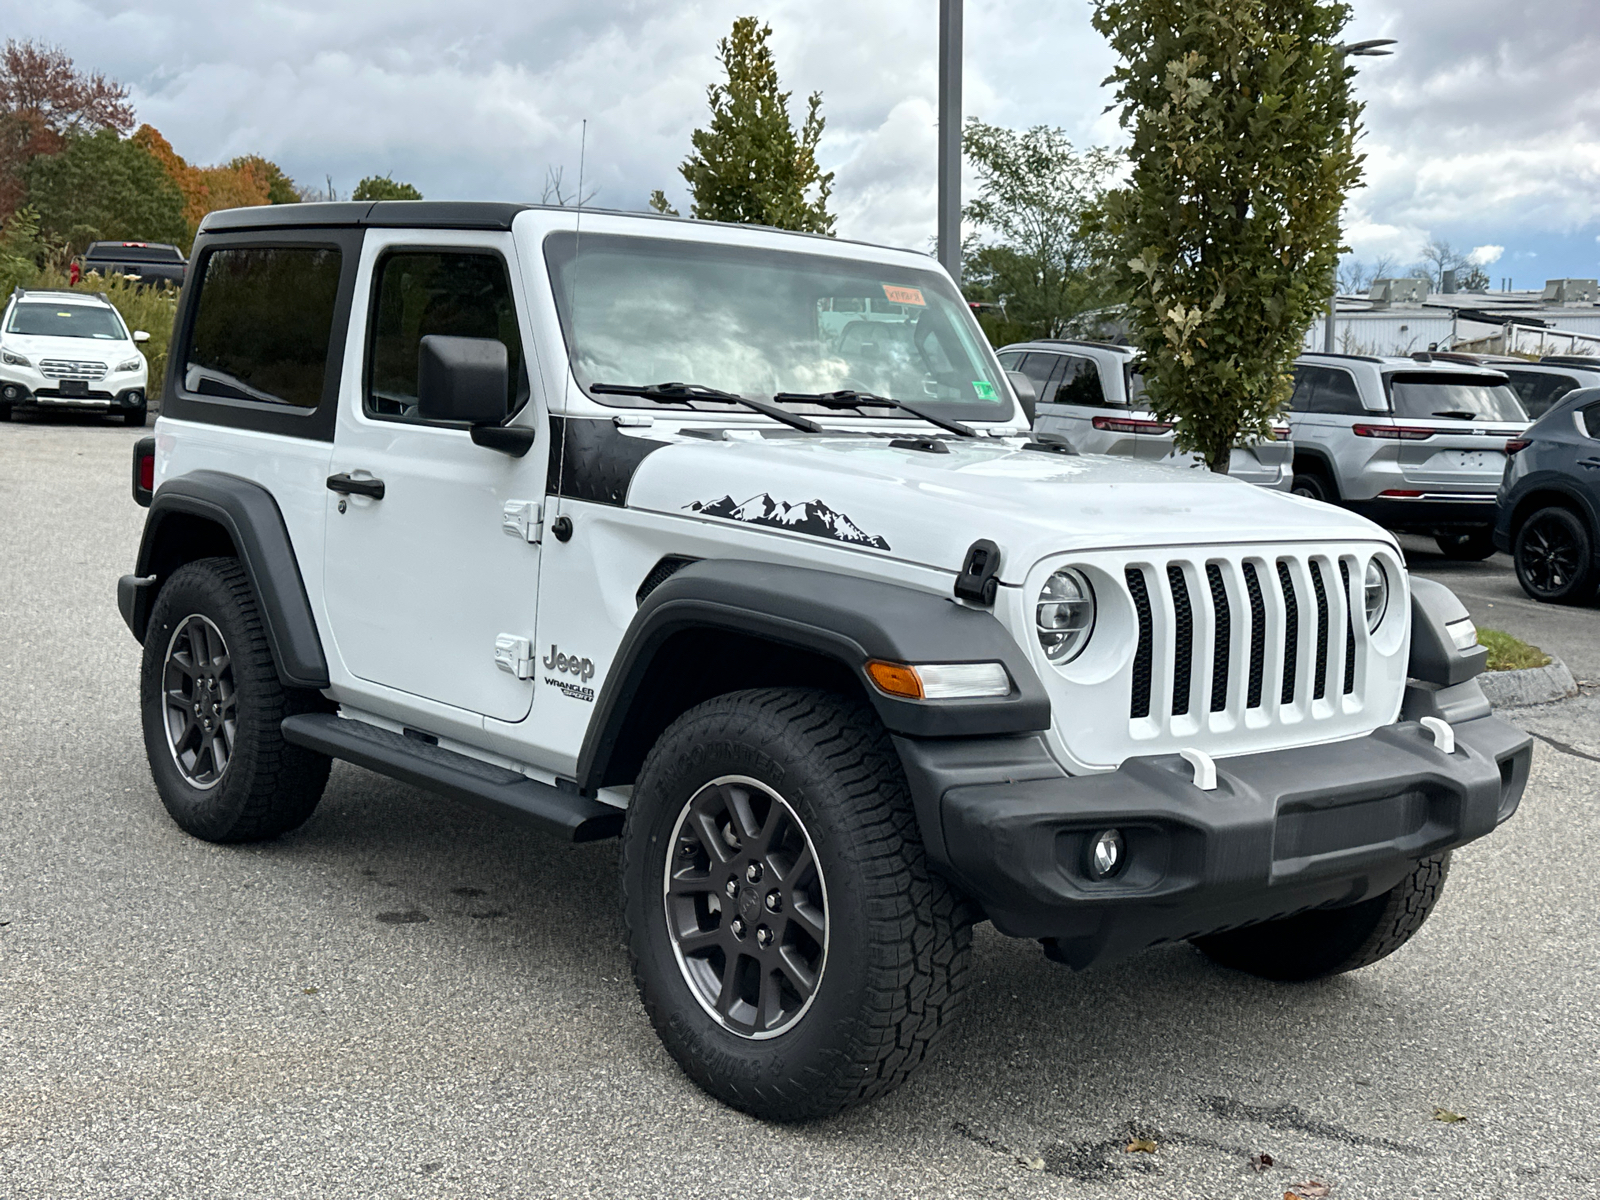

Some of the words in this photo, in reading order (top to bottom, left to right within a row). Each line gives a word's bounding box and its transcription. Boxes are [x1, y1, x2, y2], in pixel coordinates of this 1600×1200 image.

[543, 644, 595, 683] Jeep
[544, 677, 594, 696] WRANGLER
[563, 689, 593, 702] SPORT
[654, 739, 786, 804] ENCOUNTER
